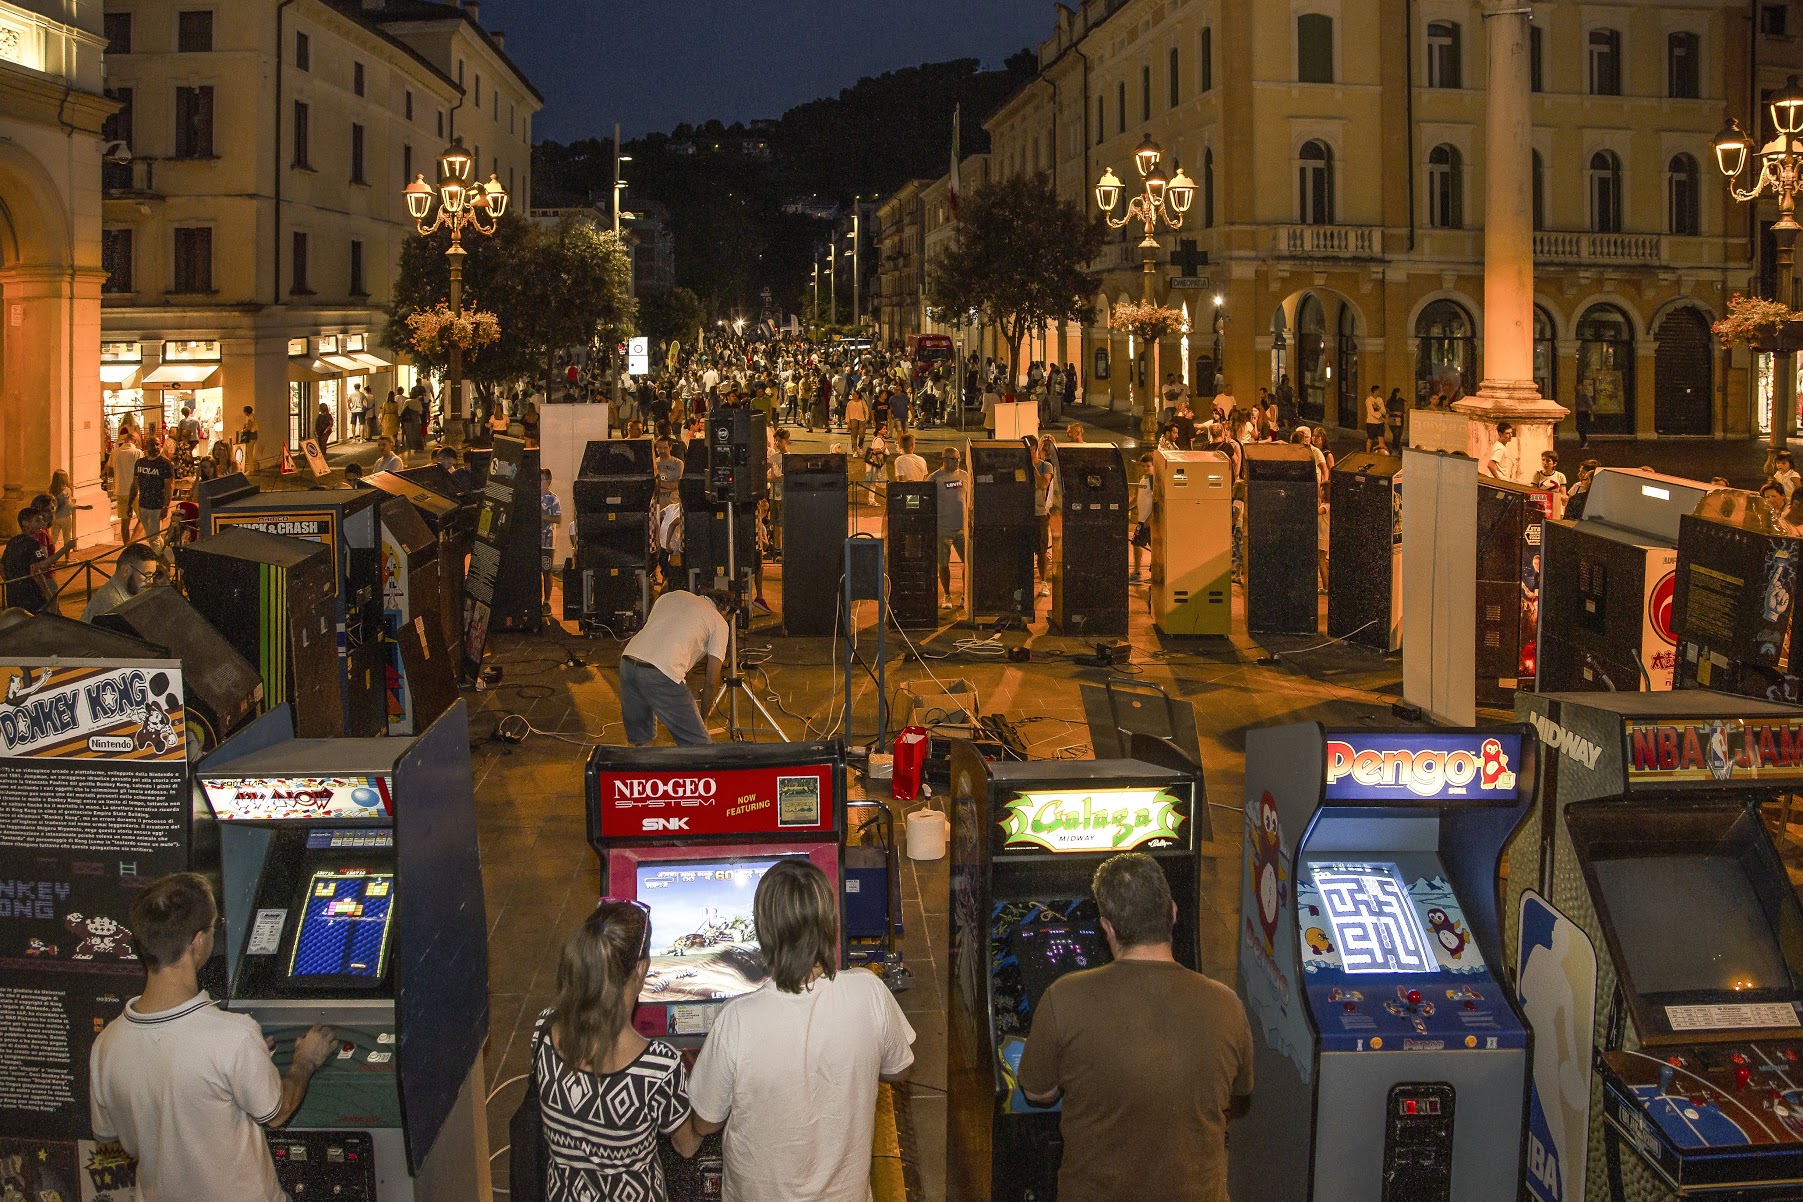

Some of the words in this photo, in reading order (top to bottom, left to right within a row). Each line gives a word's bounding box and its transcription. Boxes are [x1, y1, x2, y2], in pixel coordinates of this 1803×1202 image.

[0, 688, 80, 750] DONKEY
[84, 670, 148, 723] KONG
[92, 739, 132, 749] Nintendo
[1530, 710, 1602, 771] MIDWAY
[1632, 726, 1706, 771] NBA
[1734, 724, 1803, 768] JAM
[1327, 740, 1477, 796] Pengo
[614, 798, 716, 809] SYSTEM
[726, 800, 770, 817] FEATURING
[737, 794, 756, 805] NOW
[642, 817, 690, 831] SNK
[1030, 797, 1153, 847] Galaga
[715, 870, 734, 880] 60
[1530, 1132, 1558, 1201] BA
